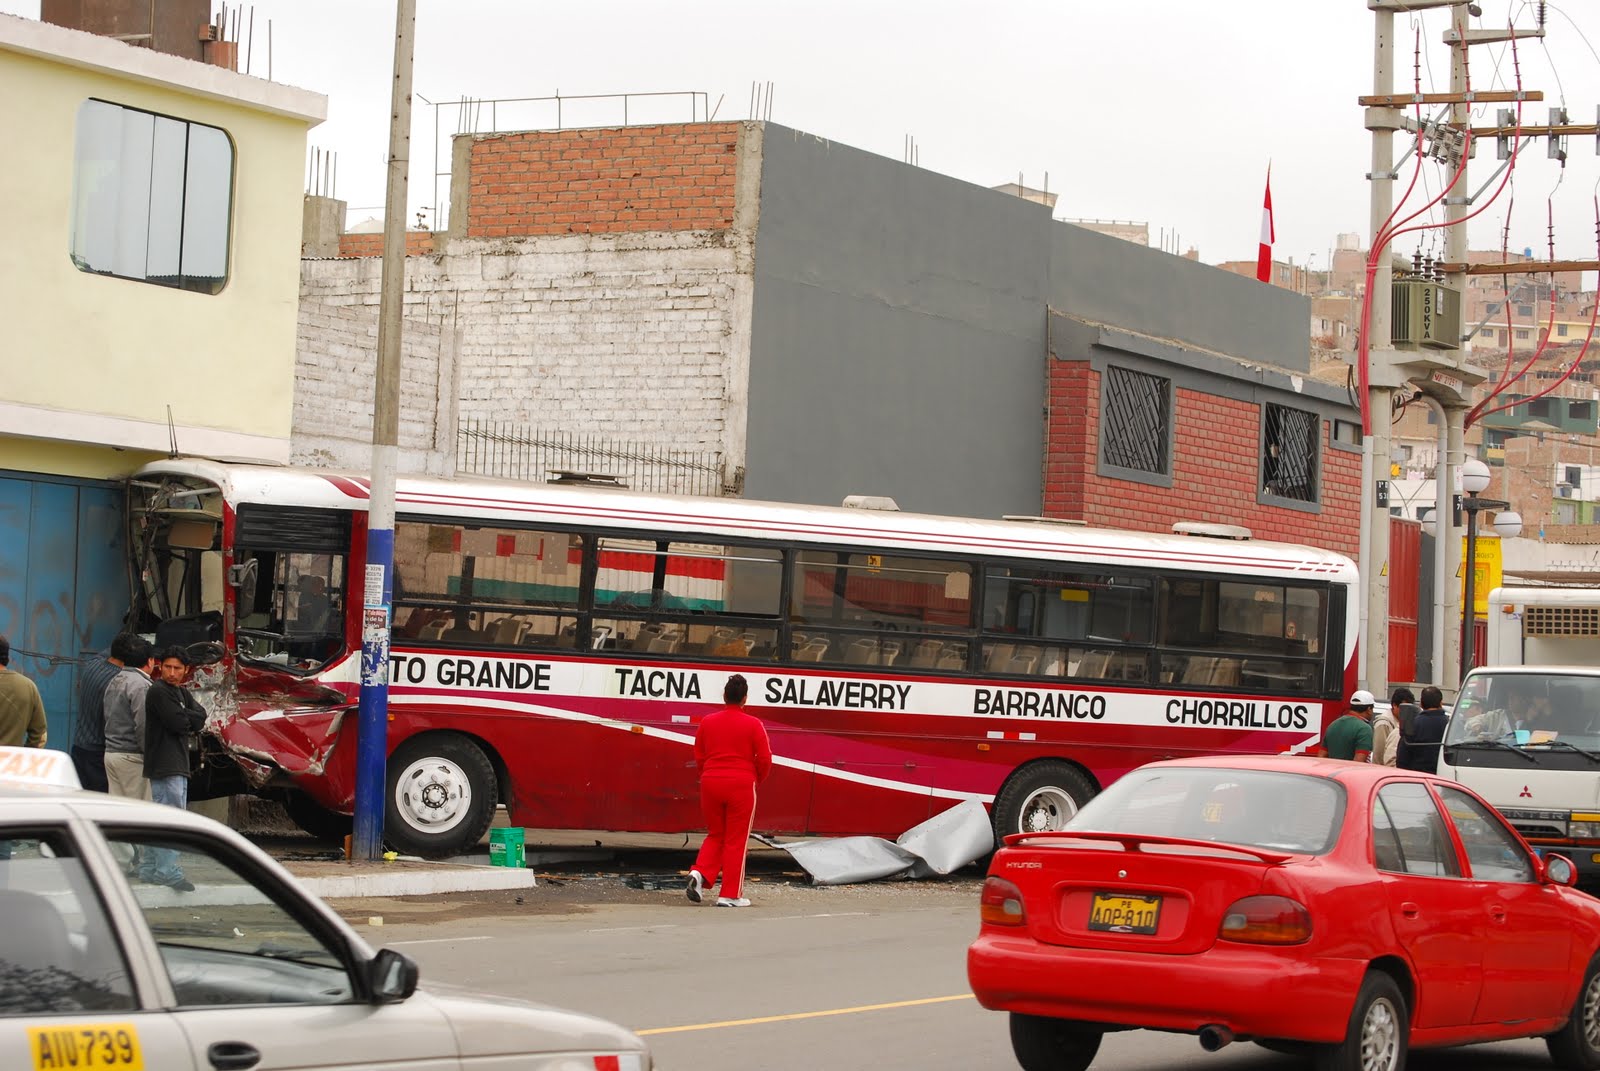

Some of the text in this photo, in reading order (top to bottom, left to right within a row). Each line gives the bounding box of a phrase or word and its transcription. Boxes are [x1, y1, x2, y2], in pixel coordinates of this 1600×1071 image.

[436, 658, 551, 691] GRANDE
[615, 668, 702, 700] TACNA
[765, 677, 911, 710] SALAVERRY
[973, 689, 1106, 720] BARRANCO
[1166, 699, 1308, 729] CHORRILLOS
